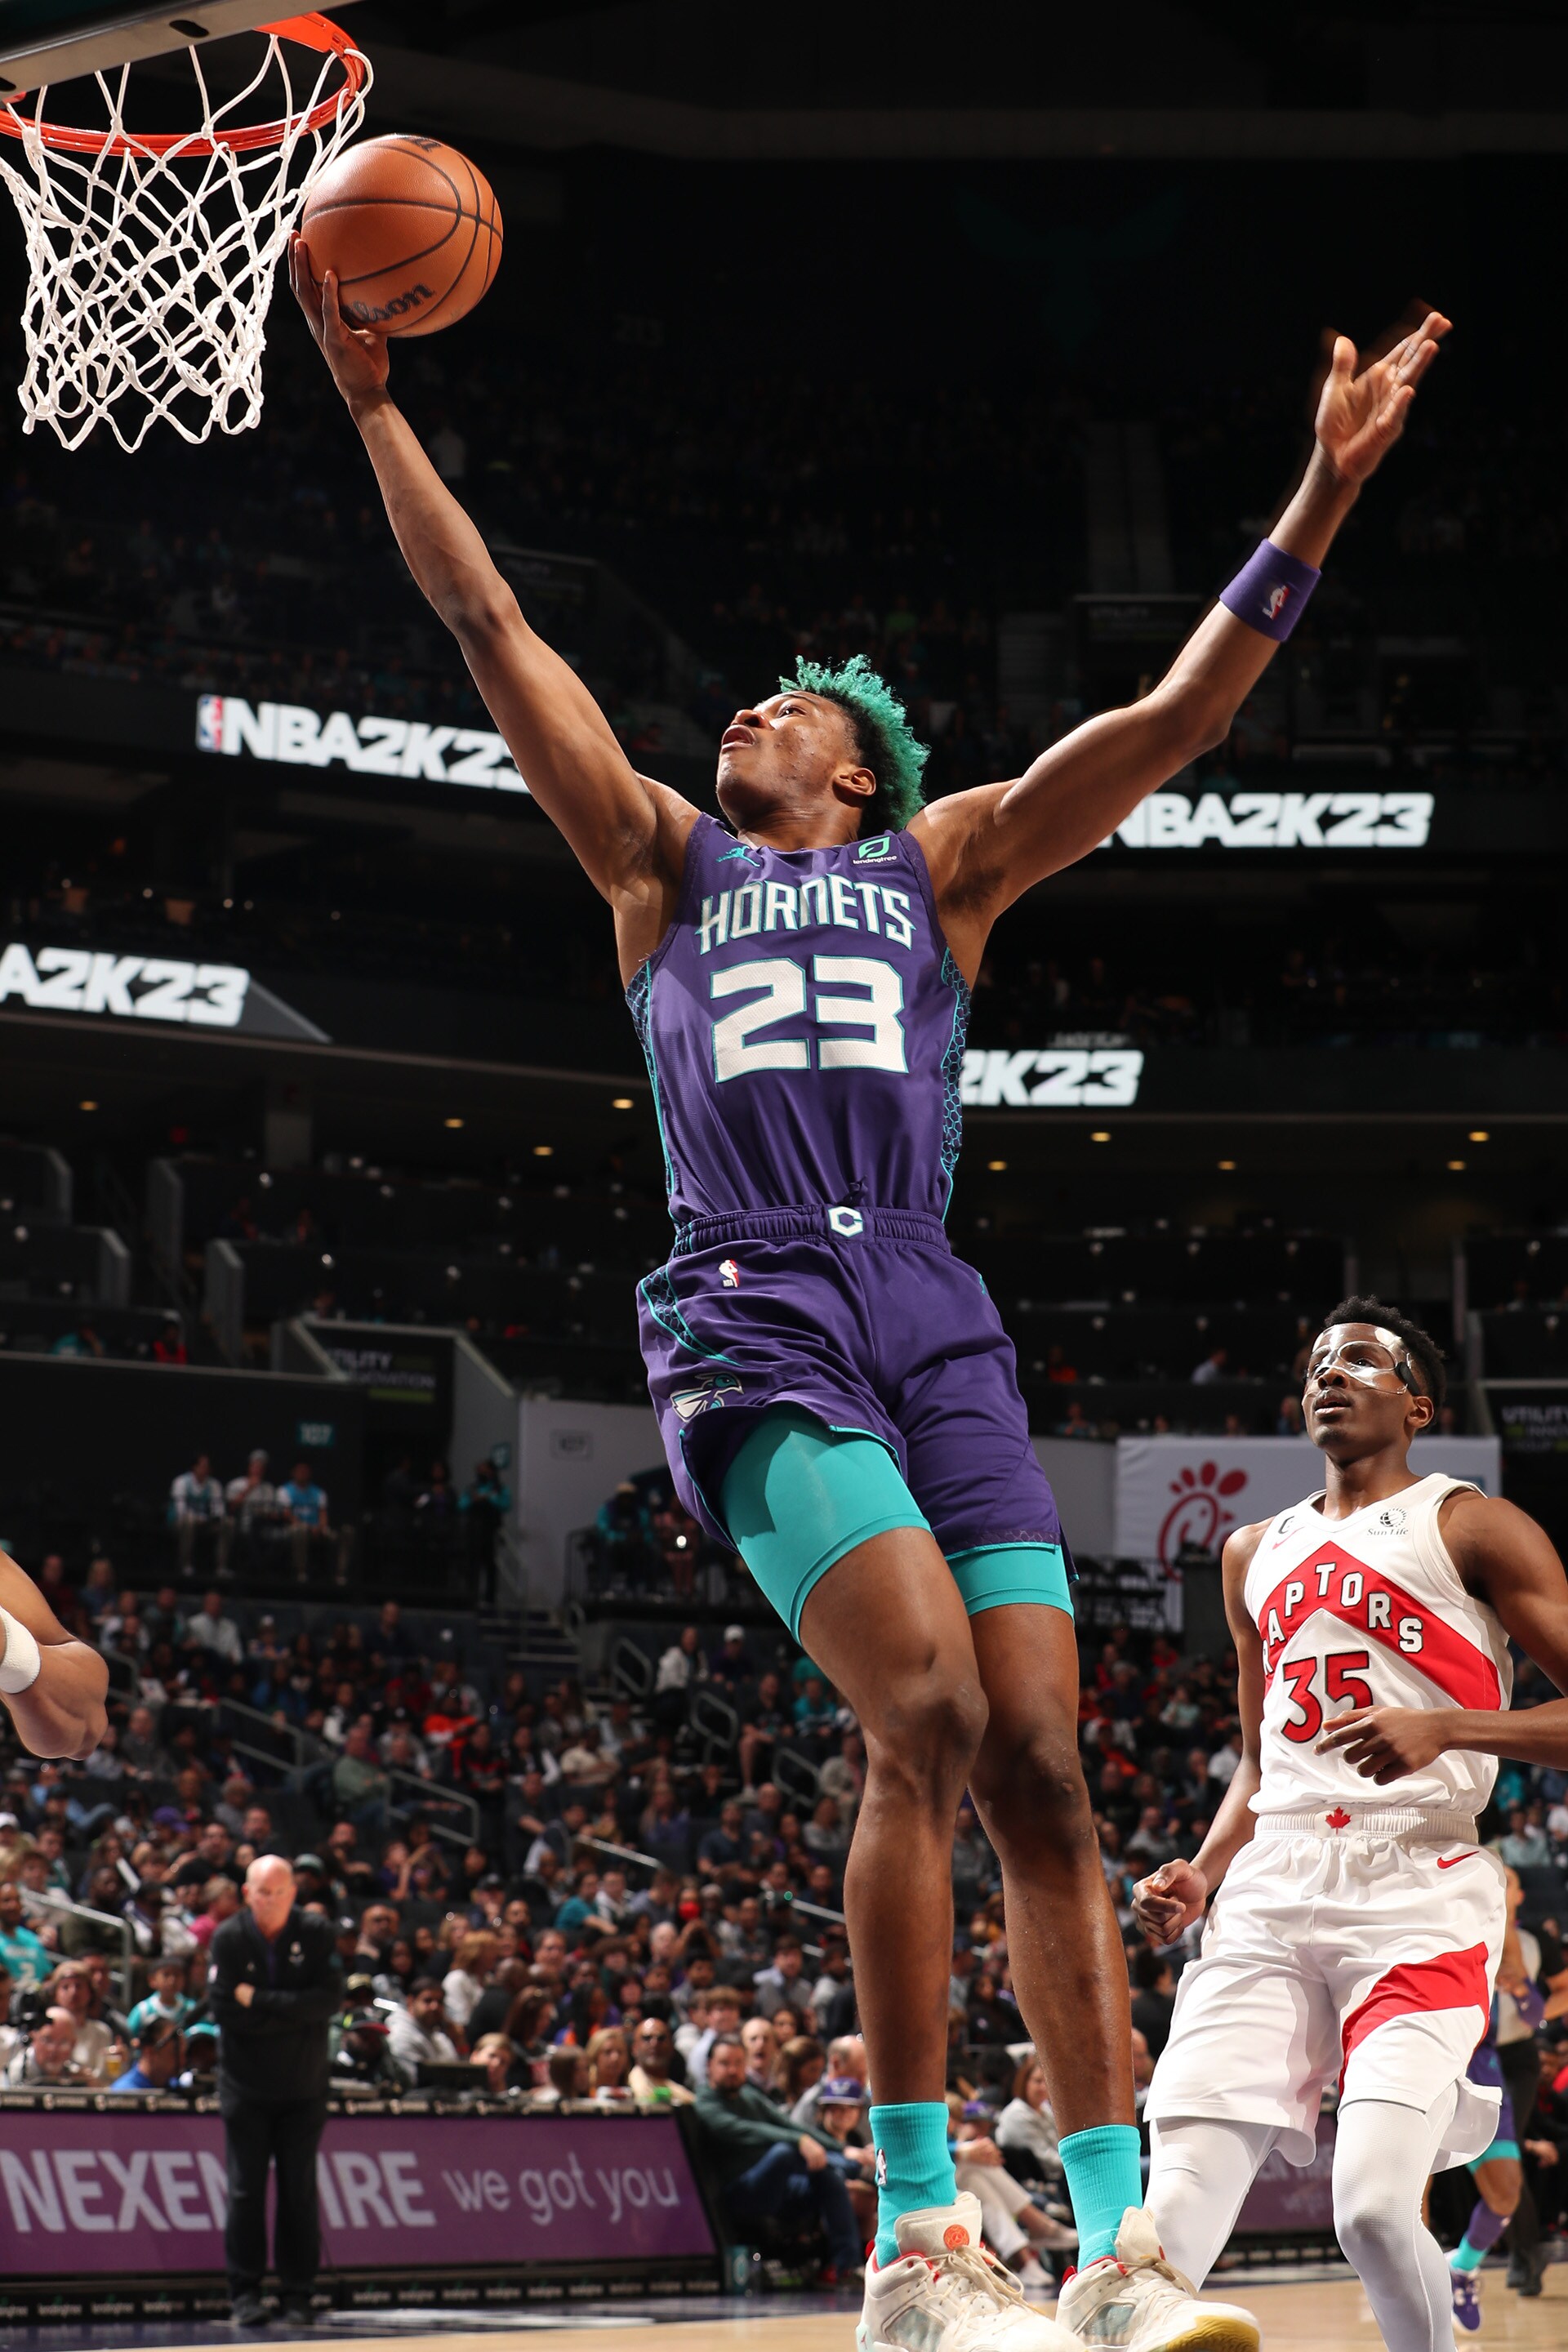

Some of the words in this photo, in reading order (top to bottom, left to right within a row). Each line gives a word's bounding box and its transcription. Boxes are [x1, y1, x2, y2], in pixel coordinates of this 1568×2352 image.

[853, 855, 898, 865] lendingtree
[696, 873, 916, 956] HORNETS
[710, 954, 910, 1084] 23
[1281, 1650, 1374, 1744] 35
[316, 2151, 437, 2229] IRE
[441, 2169, 511, 2212] we
[519, 2152, 597, 2225] got
[596, 2167, 680, 2224] you
